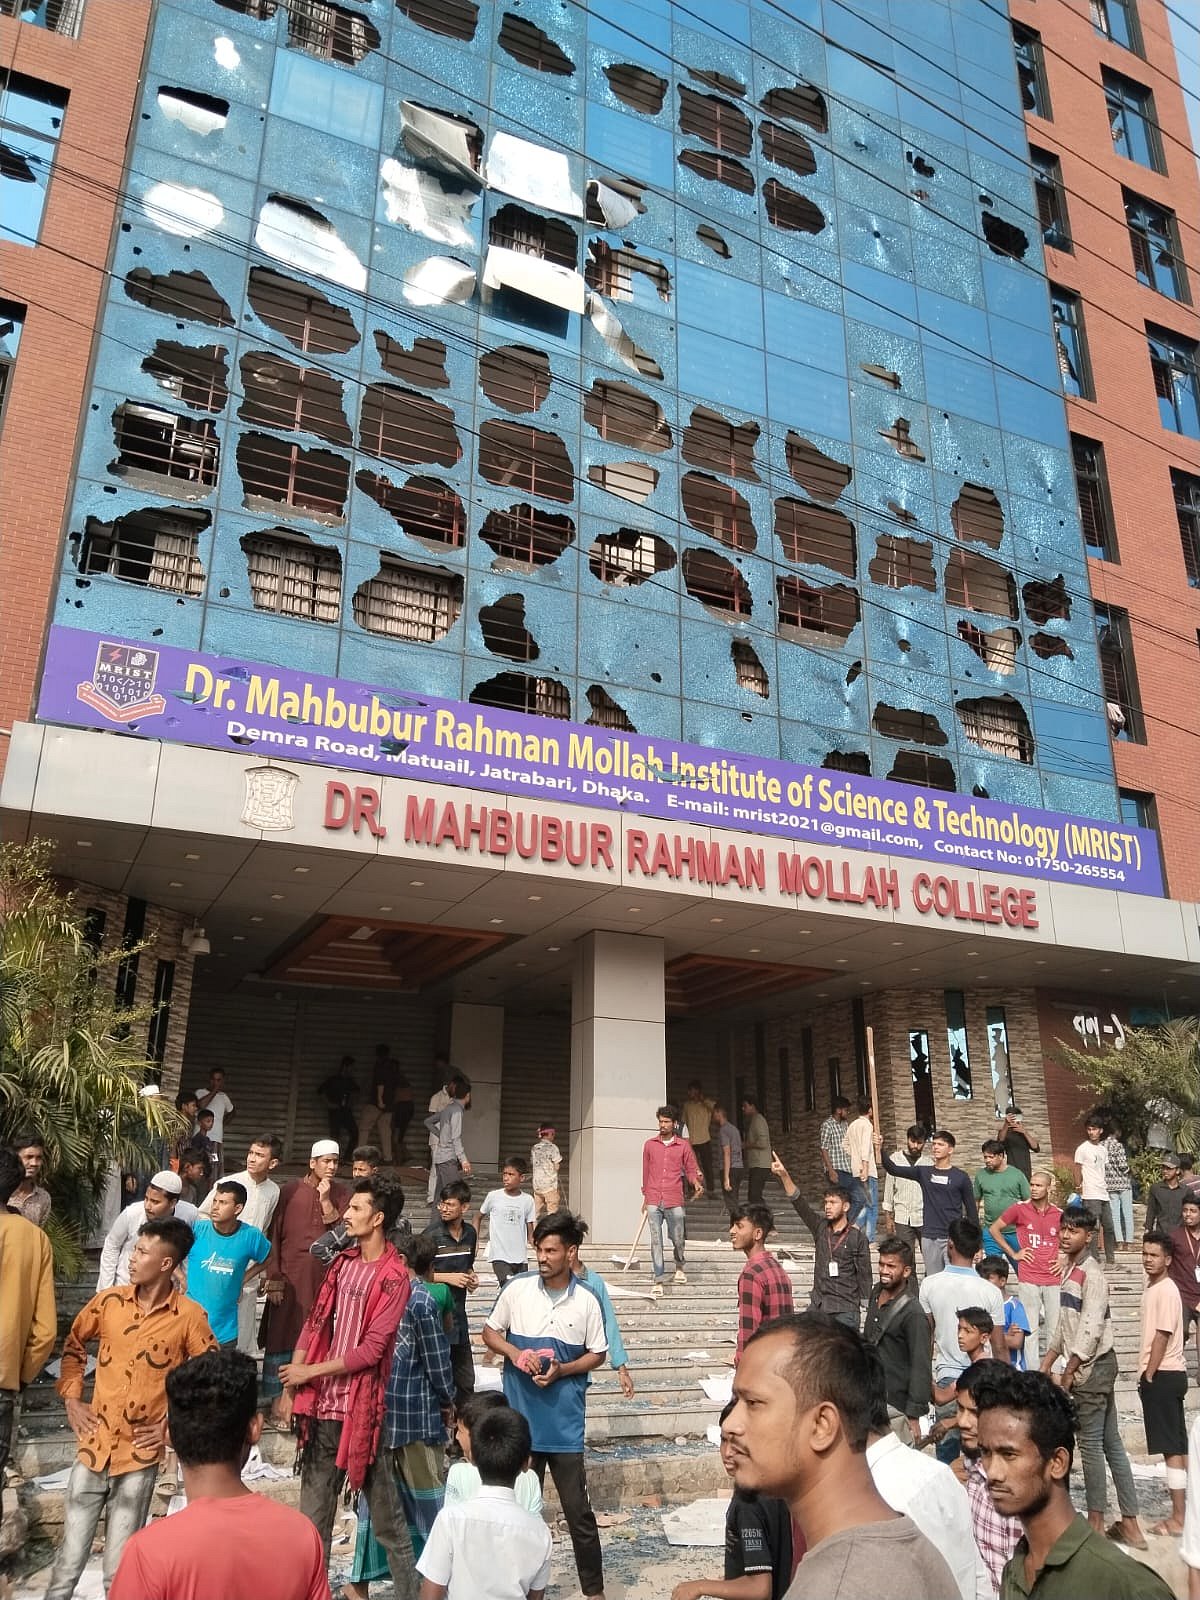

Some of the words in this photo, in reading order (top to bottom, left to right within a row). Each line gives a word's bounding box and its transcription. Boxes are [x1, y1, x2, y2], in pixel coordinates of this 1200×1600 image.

[100, 664, 151, 678] MRIST
[186, 663, 235, 710] Dr.
[246, 675, 428, 742] Mahbubur
[435, 709, 560, 765] Rahman
[568, 733, 663, 784] Mollah
[671, 751, 783, 804] Institute
[787, 775, 813, 808] of
[818, 779, 908, 826] Science
[913, 797, 930, 829] &
[933, 799, 1059, 859] Technology
[1064, 823, 1141, 871] (MRIST)
[227, 720, 308, 748] Demra
[315, 735, 381, 762] Road,
[479, 763, 578, 792] Jatrabari,
[582, 779, 650, 804] Dhaka.
[667, 794, 730, 817] E-mail:
[733, 807, 924, 850] mrist2021@gmail.com,
[934, 839, 994, 861] Contact
[996, 850, 1023, 866] No:
[1024, 855, 1126, 882] 01750-265554
[325, 781, 387, 838] DR.
[404, 795, 614, 869] MAHBUBUR
[627, 829, 766, 890] RAHMAN
[777, 851, 901, 909] MOLLAH
[912, 873, 1039, 928] COLLEGE
